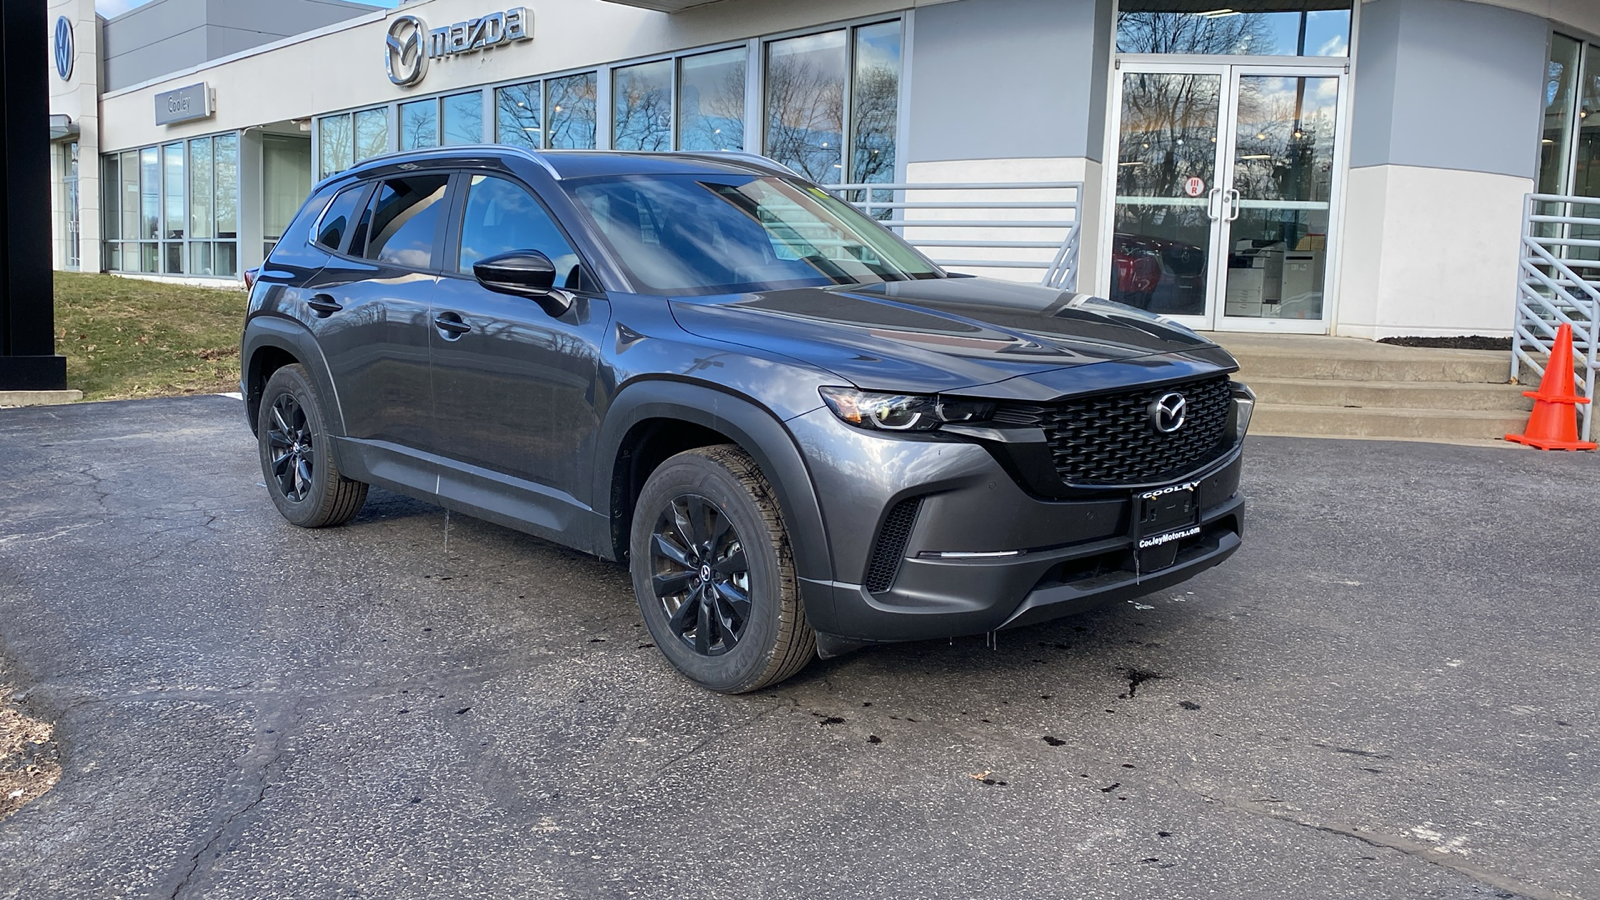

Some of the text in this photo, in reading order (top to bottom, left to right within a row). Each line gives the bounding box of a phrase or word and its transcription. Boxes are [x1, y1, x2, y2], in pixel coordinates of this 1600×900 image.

[167, 91, 191, 115] Cooley
[1142, 480, 1201, 499] COOLEY
[1139, 527, 1201, 548] CooleyMotors.com
